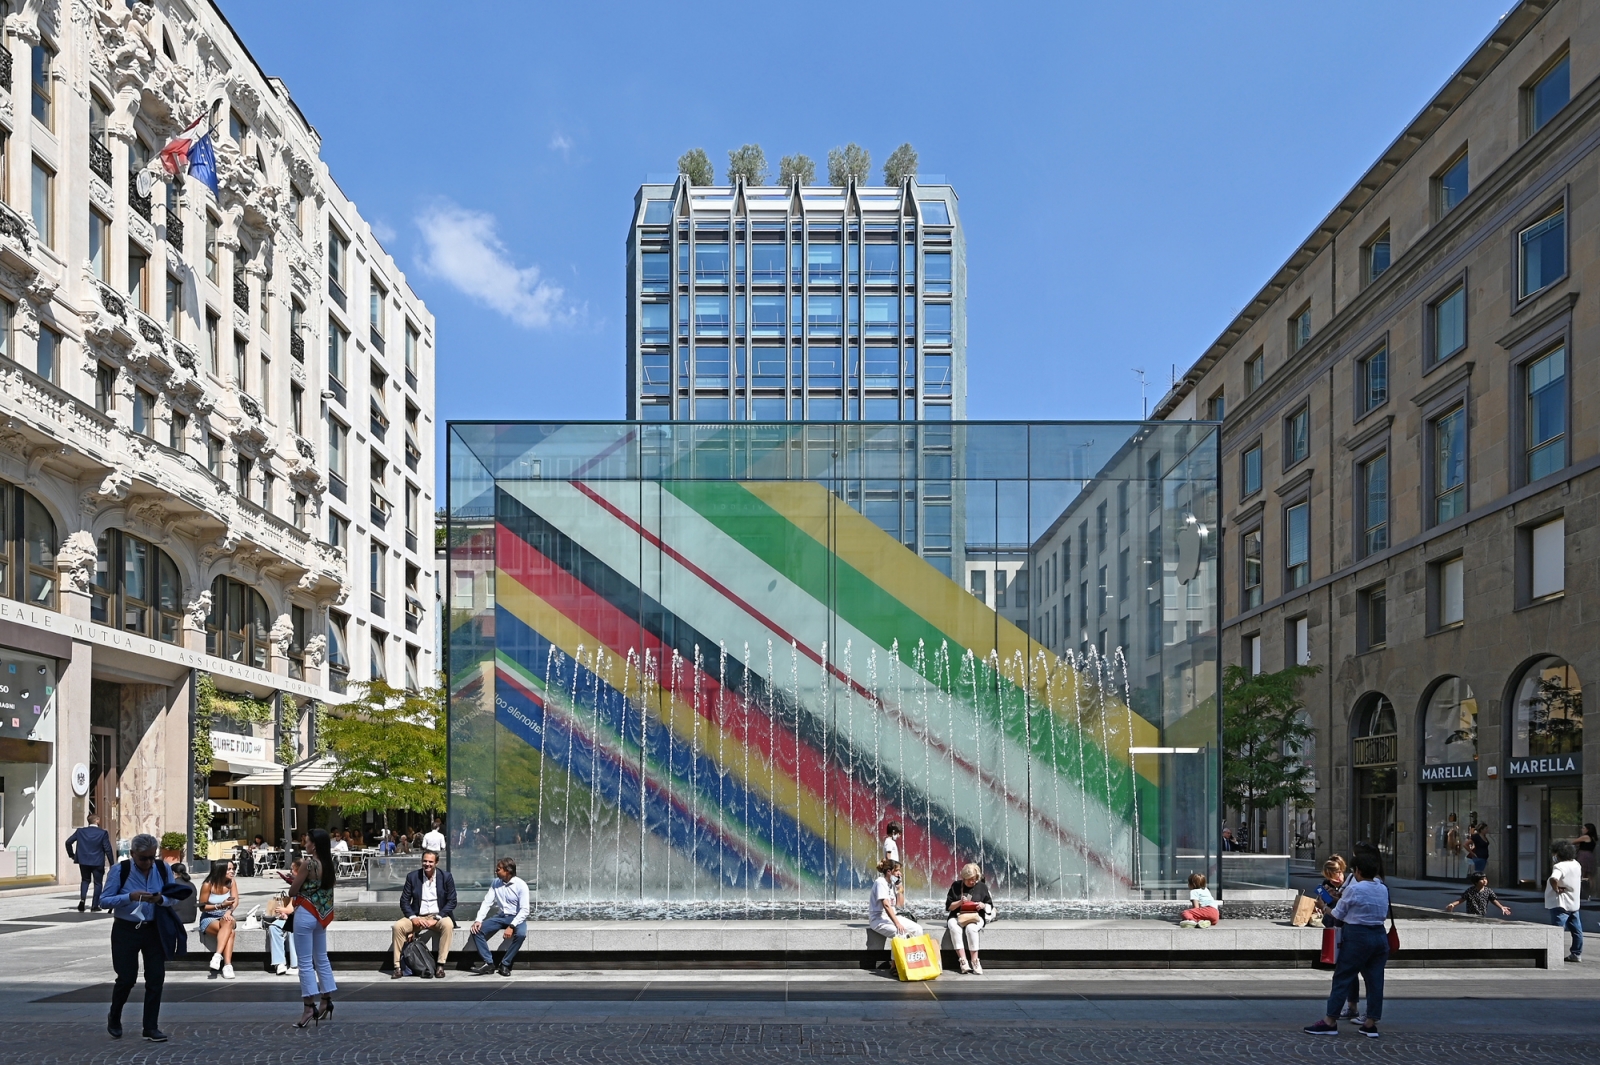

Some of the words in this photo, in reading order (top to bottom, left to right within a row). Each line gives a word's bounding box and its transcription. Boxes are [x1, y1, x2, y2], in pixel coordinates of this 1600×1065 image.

[73, 623, 132, 649] MUTUA
[149, 643, 163, 656] DI
[178, 652, 275, 685] ASSICURAZIONI
[284, 680, 319, 696] TORINO
[210, 736, 236, 752] QUARE
[236, 740, 253, 754] FOOD
[1422, 765, 1472, 780] MARELLA
[1509, 757, 1575, 774] MARELLA
[907, 951, 927, 962] LEGO
